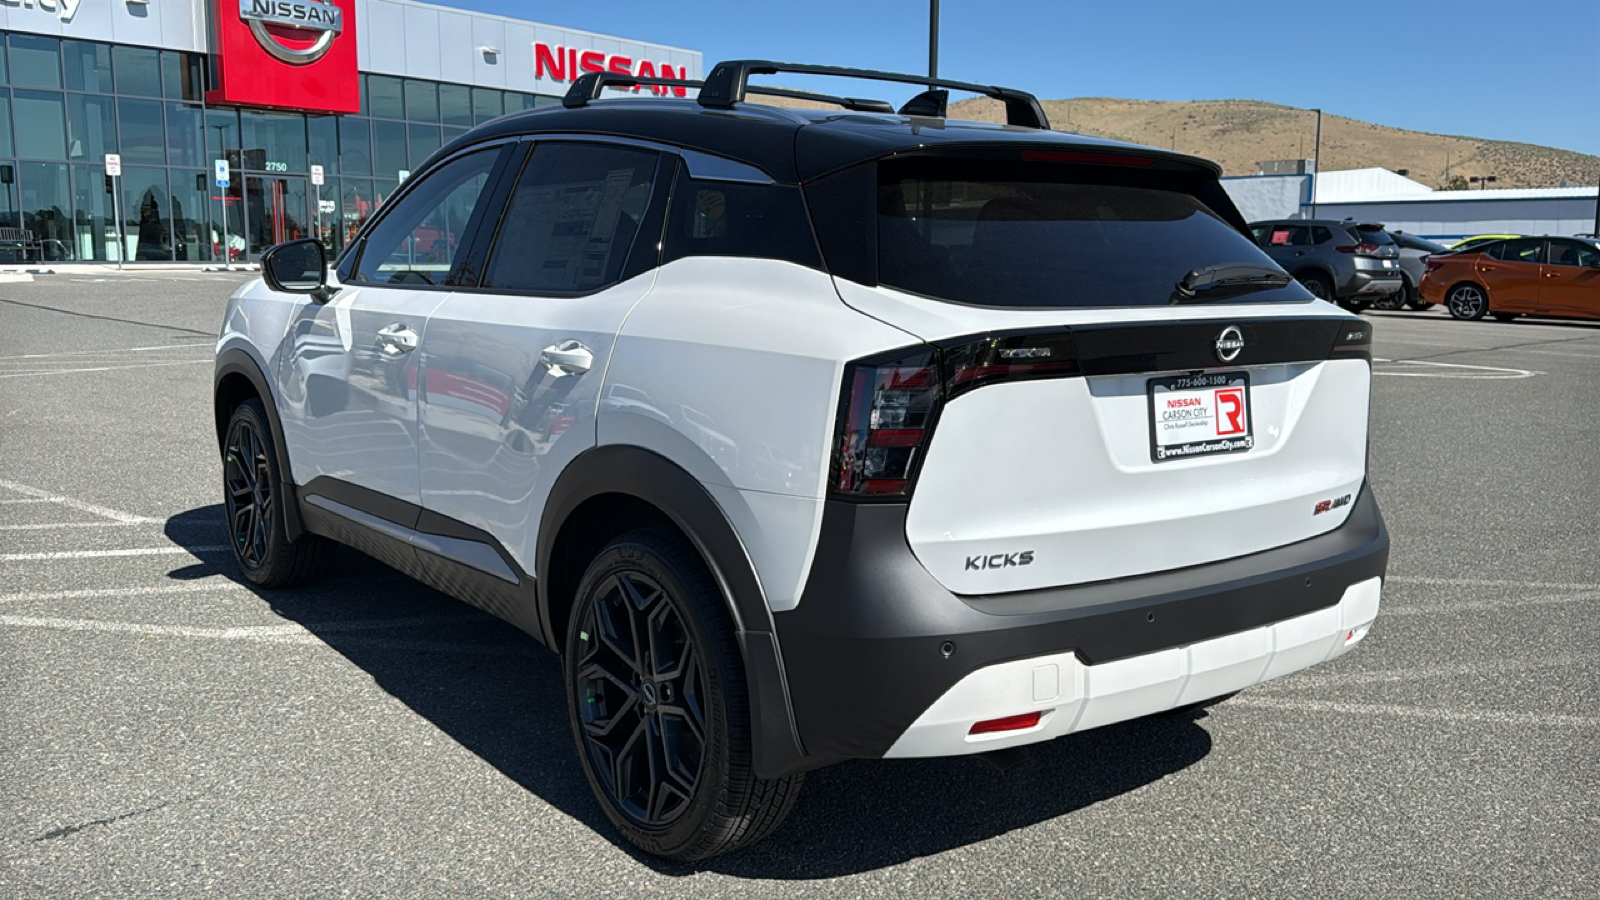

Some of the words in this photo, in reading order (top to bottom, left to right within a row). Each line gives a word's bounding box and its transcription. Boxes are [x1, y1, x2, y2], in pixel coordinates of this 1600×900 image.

[252, 0, 336, 25] NISSAN
[534, 43, 687, 98] NISSAN
[265, 161, 288, 172] 2750
[1216, 340, 1245, 350] NISSAN
[1177, 375, 1227, 388] 775-600-1500
[1166, 397, 1202, 409] NISSAN
[1162, 409, 1192, 421] CARSON
[1193, 407, 1208, 417] CITY
[1166, 440, 1245, 457] www.NissanCarsonCity.com
[964, 550, 1035, 571] KICKS
